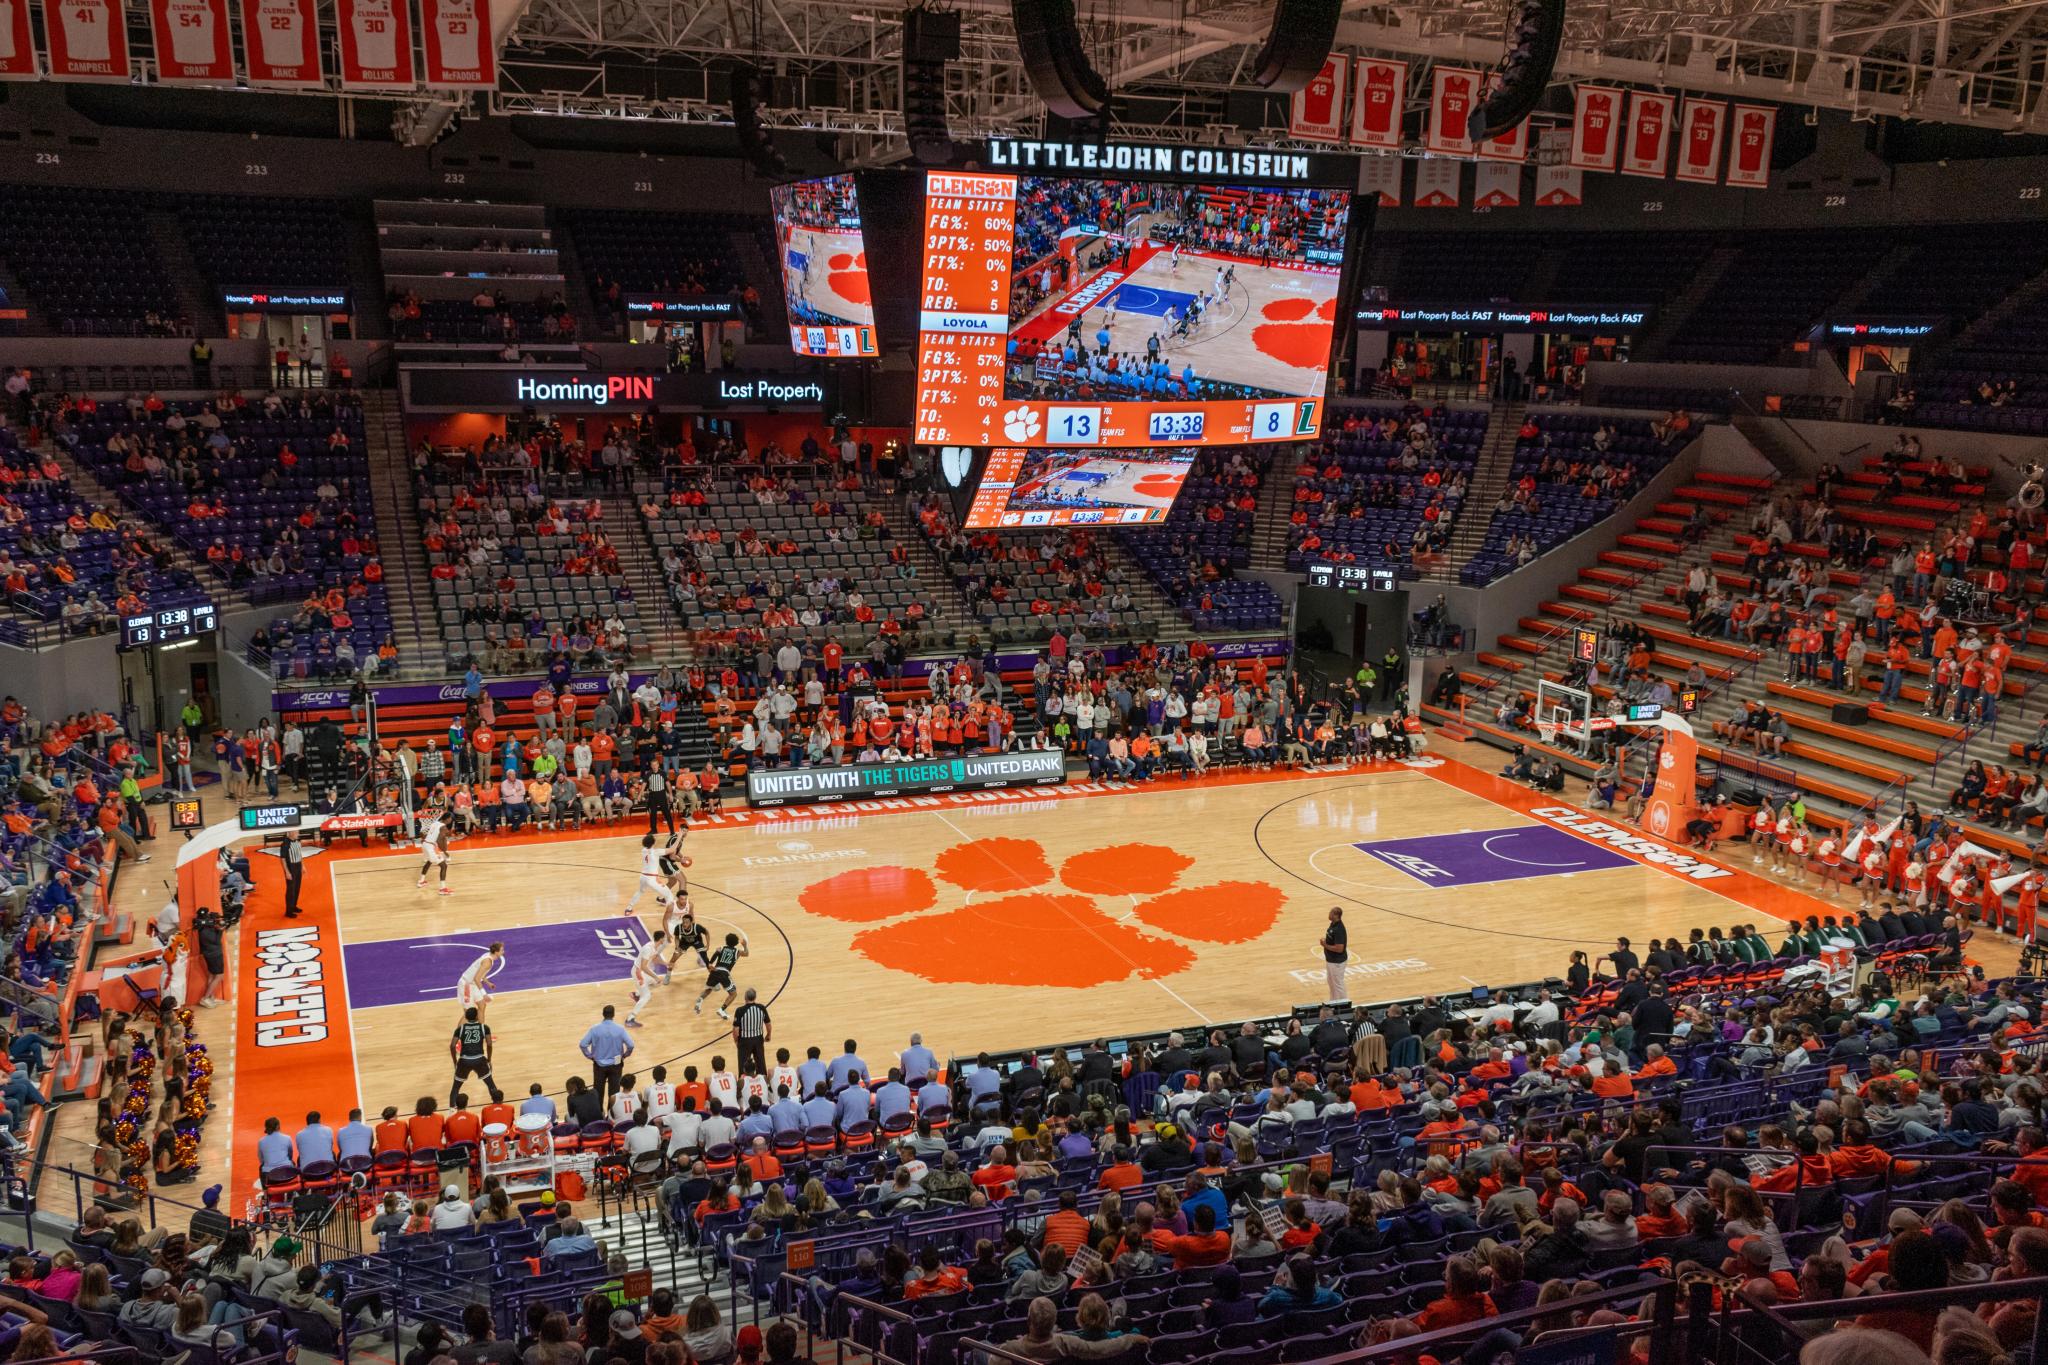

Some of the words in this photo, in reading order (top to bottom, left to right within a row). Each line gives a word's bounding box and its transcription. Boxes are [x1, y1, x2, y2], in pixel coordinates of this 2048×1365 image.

[75, 9, 95, 23] 41
[262, 7, 296, 15] CLEMSON
[357, 10, 390, 18] CLEMSON
[441, 12, 473, 20] CLEMSON
[180, 13, 202, 27] 54
[270, 17, 291, 30] 22
[365, 20, 385, 33] 30
[449, 22, 467, 34] 23
[68, 61, 113, 73] CAMPBELL
[183, 64, 210, 76] GRANT
[272, 67, 299, 79] NANCE
[362, 70, 395, 81] ROLLINS
[442, 71, 481, 81] McFADDEN
[1312, 84, 1327, 96] 42
[1371, 91, 1386, 103] 23
[1448, 100, 1462, 112] 32
[1590, 117, 1604, 128] 30
[1643, 124, 1655, 134] 25
[1696, 130, 1709, 141] 33
[1746, 135, 1759, 145] 32
[36, 153, 60, 165] 234
[991, 141, 1172, 171] LITTLEJOHN
[1180, 151, 1309, 179] COLISEUM
[245, 164, 268, 176] 233
[444, 173, 465, 184] 232
[634, 182, 653, 192] 231
[2019, 188, 2040, 200] 223
[930, 198, 963, 210] TEAM
[968, 200, 1005, 212] STATS
[1642, 201, 1663, 212] 225
[1825, 196, 1846, 207] 224
[929, 215, 969, 230] FG%:
[984, 218, 1012, 231] 60%
[927, 235, 975, 251] 3PT%:
[984, 239, 1012, 253] 50%
[927, 255, 964, 270] FT%:
[986, 259, 1006, 272] 0%
[927, 277, 949, 291] TO:
[990, 279, 999, 292] 3
[283, 296, 310, 305] Property
[311, 296, 326, 304] Back
[327, 296, 344, 304] FAST
[924, 295, 958, 310] REB:
[990, 299, 998, 311] 5
[678, 303, 701, 311] Property
[1401, 310, 1417, 320] Lost
[1418, 311, 1450, 322] Property
[1451, 311, 1470, 321] Back
[1471, 312, 1493, 321] FAST
[1549, 313, 1565, 322] Lost
[1566, 313, 1599, 324] Property
[1600, 314, 1620, 323] Back
[1621, 314, 1643, 324] FAST
[943, 318, 988, 329] LOYOLA
[1880, 326, 1904, 335] Property
[808, 331, 825, 346] 13:38
[844, 334, 851, 349] 8
[924, 334, 955, 345] TEAM
[961, 335, 996, 346] STATS
[923, 351, 961, 365] FG%:
[977, 354, 1004, 367] 57%
[922, 369, 968, 384] 3PT%:
[979, 375, 999, 388] 0%
[720, 380, 753, 398] Lost
[758, 381, 823, 401] Property
[921, 390, 957, 404] FT%:
[978, 395, 997, 407] 0%
[920, 409, 942, 422] TO:
[982, 415, 990, 426] 4
[1268, 412, 1280, 432] 8
[1296, 401, 1317, 435] L
[1063, 415, 1092, 437] 13
[1152, 415, 1203, 434] 13:38
[918, 427, 951, 441] REB:
[981, 433, 989, 444] 3
[1074, 512, 1103, 521] 13:38
[1341, 568, 1367, 579] 13:38
[1318, 576, 1328, 586] 13
[1385, 581, 1392, 590] 8
[161, 610, 188, 626] 13:38
[206, 617, 214, 629] 8
[137, 628, 149, 641] 13
[159, 629, 166, 639] 2
[183, 626, 190, 635] 3
[1218, 643, 1245, 654] ACCN
[1584, 643, 1593, 659] 12
[300, 692, 333, 702] ACCN
[1637, 704, 1661, 713] UNITED
[754, 774, 813, 794] UNITED
[817, 771, 859, 790] WITH
[862, 769, 893, 787] THE
[895, 764, 949, 783] TIGERS
[967, 760, 1021, 777] UNITED
[1023, 757, 1062, 772] BANK
[1037, 776, 1060, 784] GEICO
[930, 785, 953, 793] GEICO
[984, 780, 1007, 788] GEICO
[176, 802, 198, 812] 13:38
[686, 796, 942, 826] LITTLEJOHN
[949, 781, 1138, 803] COLISEUM
[758, 798, 783, 806] GEICO
[181, 813, 194, 824] 12
[257, 807, 297, 818] UNITED
[258, 816, 287, 826] BANK
[1530, 806, 1738, 879] CLEMSON
[742, 848, 867, 866] FOUNDERS
[1374, 849, 1455, 877] ACC
[594, 927, 639, 961] ACC
[255, 925, 329, 1048] CLEMSON
[464, 1030, 481, 1044] 23
[718, 1079, 731, 1091] 10
[779, 1076, 793, 1088] 24
[750, 1085, 763, 1096] 22
[657, 1094, 668, 1106] 21
[623, 1100, 633, 1114] 11
[629, 1282, 647, 1293] 108
